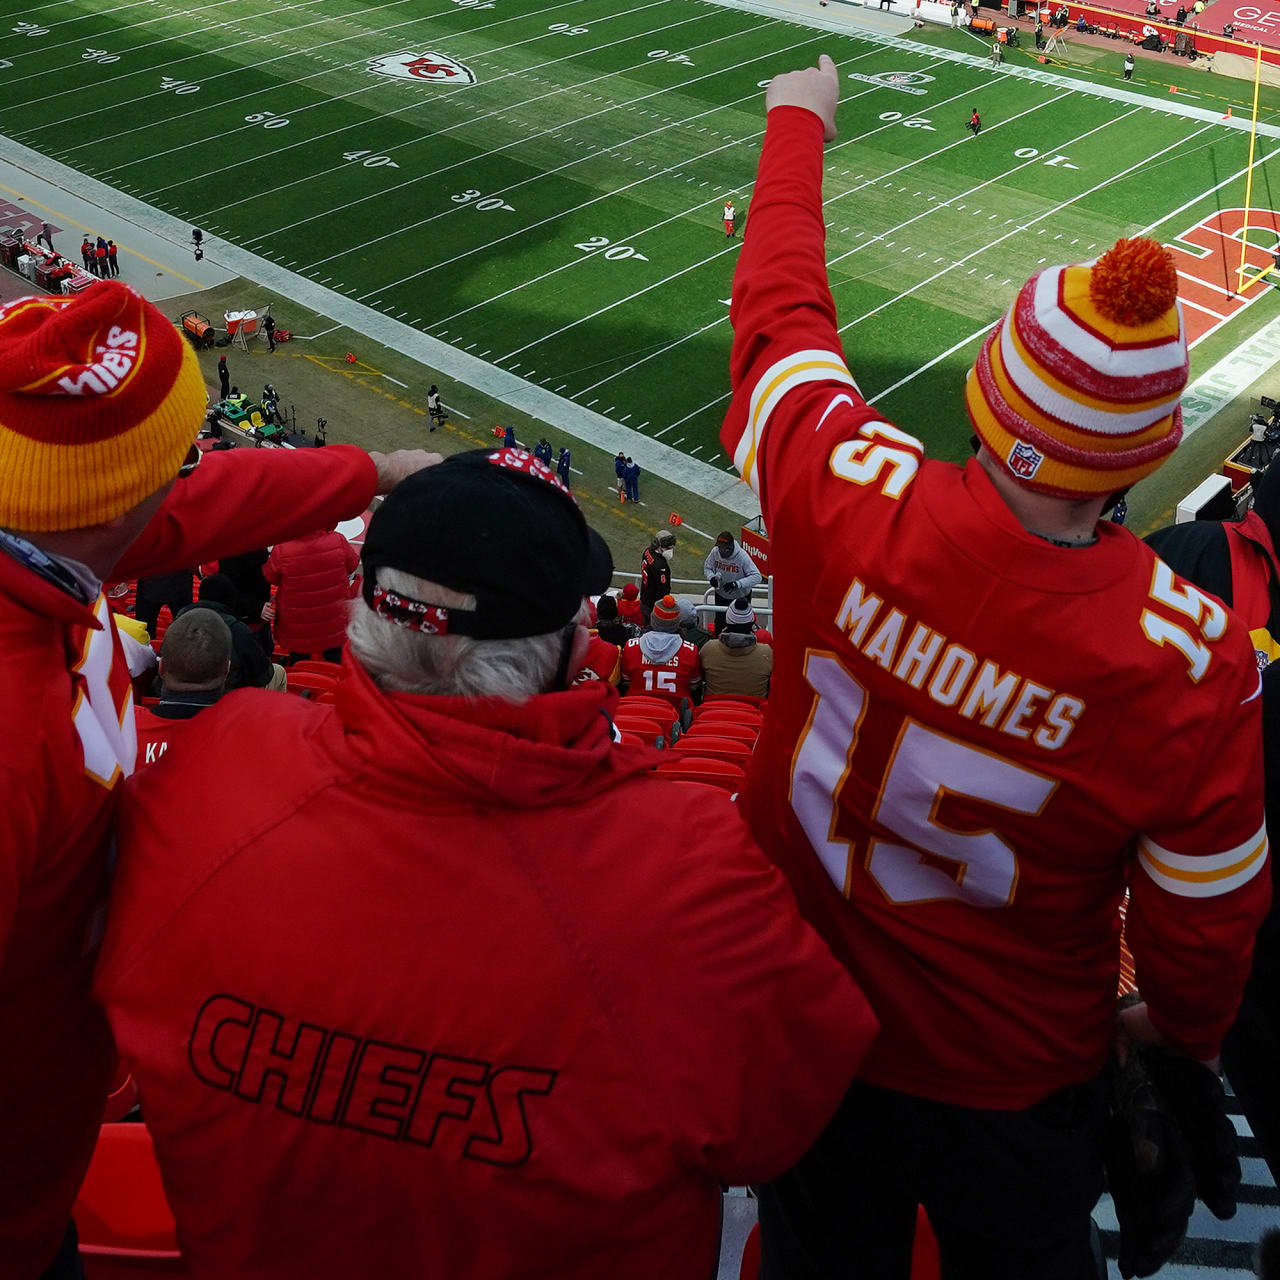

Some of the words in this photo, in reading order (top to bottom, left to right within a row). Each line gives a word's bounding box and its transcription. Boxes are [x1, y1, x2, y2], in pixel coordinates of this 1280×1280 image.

[11, 21, 50, 37] 20
[1233, 21, 1268, 33] MEDICAL
[81, 48, 121, 64] 30
[160, 78, 200, 95] 40
[244, 111, 290, 129] 50
[878, 111, 932, 129] 20
[342, 150, 391, 168] 40
[1013, 147, 1071, 167] 10
[450, 189, 505, 211] 30
[574, 236, 635, 260] 20
[830, 420, 924, 500] 15
[1139, 556, 1228, 684] 15
[834, 576, 1085, 751] MAHOMES
[642, 670, 677, 693] 15
[789, 647, 1061, 909] 15
[187, 992, 559, 1169] CHIEFS
